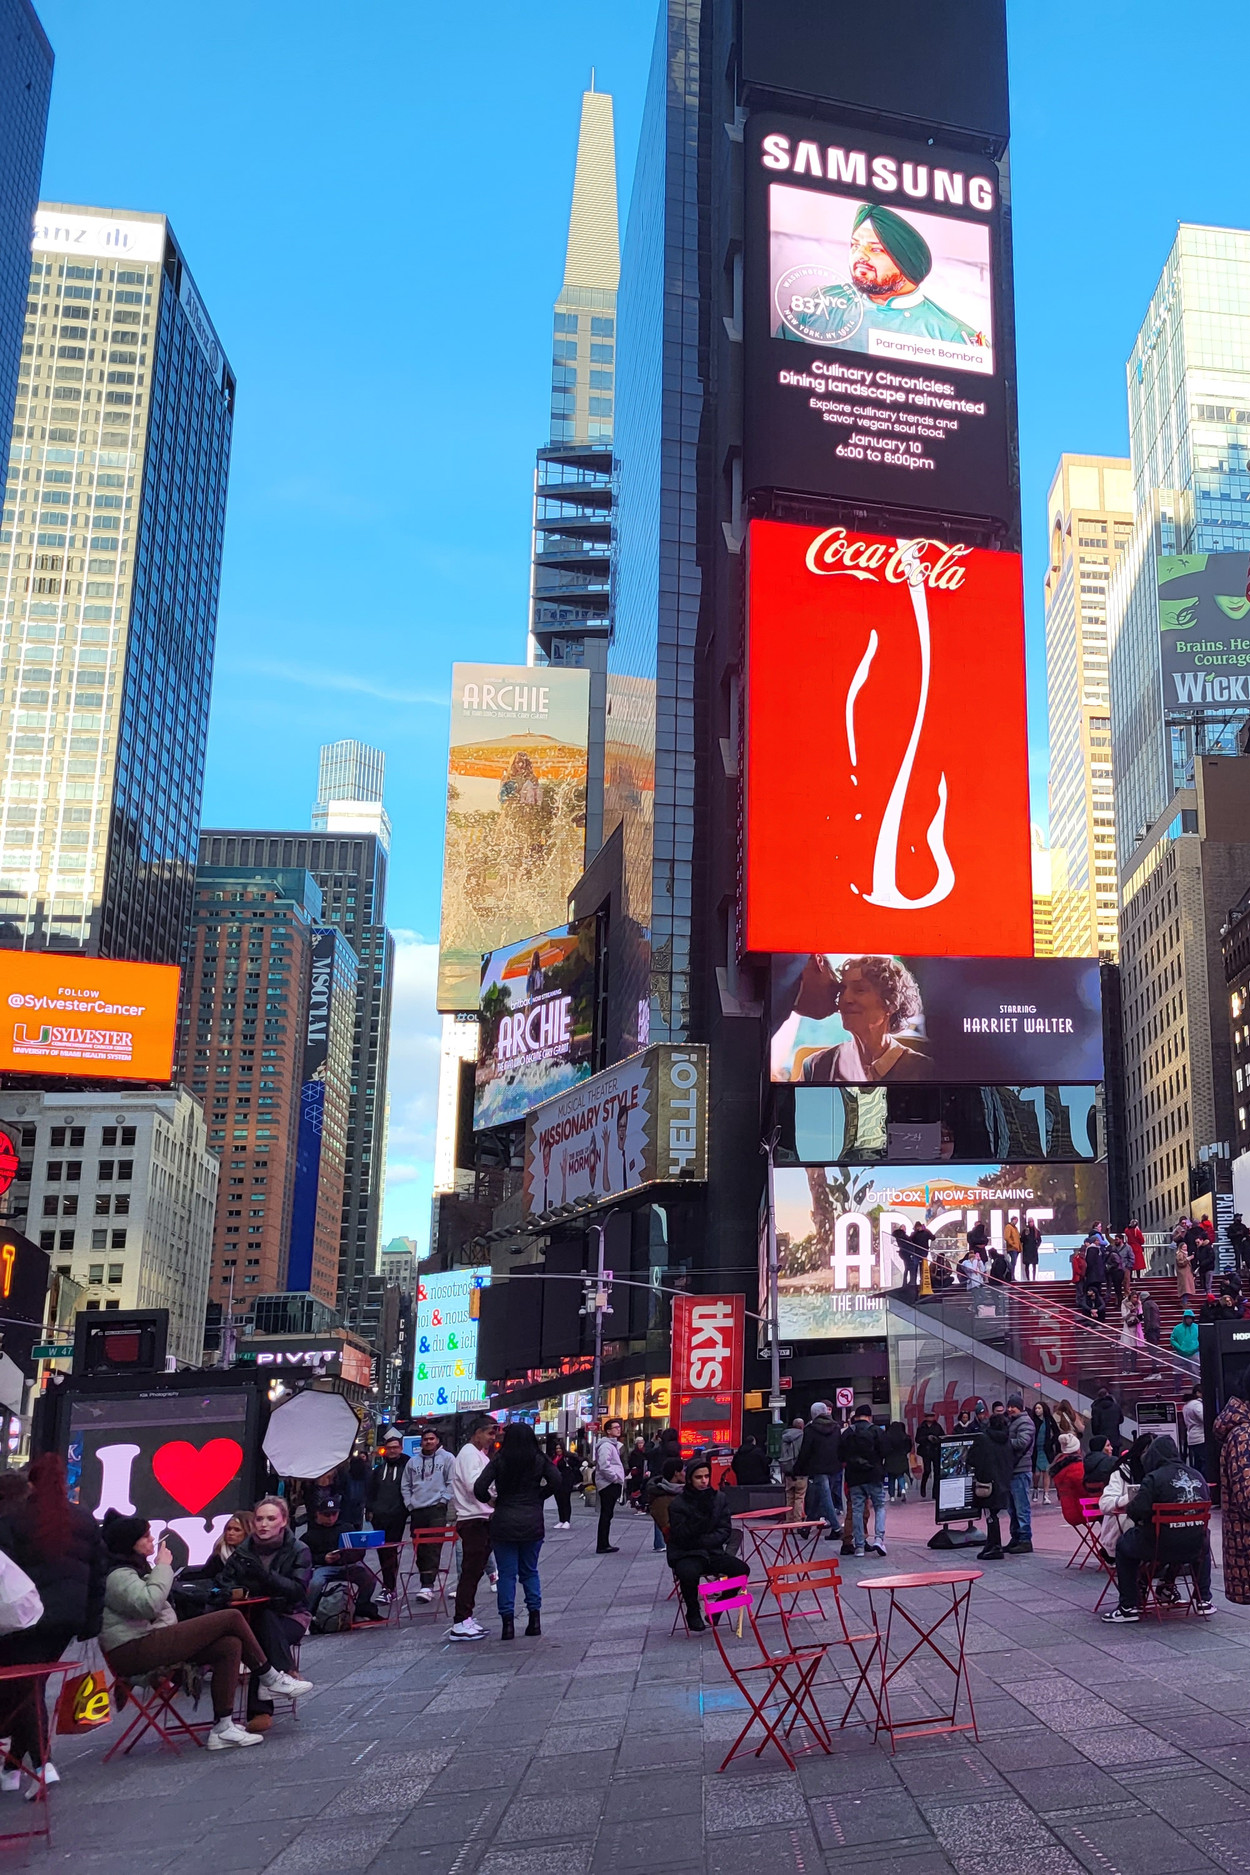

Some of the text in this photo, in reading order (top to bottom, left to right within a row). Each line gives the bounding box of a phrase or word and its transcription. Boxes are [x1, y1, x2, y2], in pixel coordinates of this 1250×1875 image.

[762, 133, 994, 211] SAMSUNG
[876, 338, 984, 364] Paramjeet Bombra
[811, 361, 955, 395] Culinary Chronicles:
[779, 371, 985, 415] Dining landscape reinvented
[809, 398, 958, 430] Explore culinary trends and
[823, 412, 945, 439] savor vegan soul food.
[848, 433, 922, 453] January 10
[835, 444, 934, 470] 6:00 to 8:00pm
[805, 527, 974, 591] Coca-Cola
[1176, 639, 1227, 653] Brains.
[462, 683, 550, 713] ARCHIE
[8, 993, 146, 1016] @SylvesterCancer
[58, 987, 100, 998] FOLLOW
[1000, 1005, 1037, 1014] STARRING
[52, 1027, 133, 1046] SYLVESTER
[497, 996, 571, 1060] ARCHIE
[963, 1018, 1074, 1033] HARRIET WALTER
[12, 1046, 50, 1056] UNIVERSITY
[558, 1077, 618, 1119] MUSICAL THEATER
[539, 1084, 639, 1152] MISSIONARY STYLE
[668, 1052, 698, 1175] HELLO!
[866, 1187, 1034, 1203] britbox NOW STREAMING
[430, 1281, 472, 1299] nosotros
[831, 1295, 852, 1311] THE
[445, 1310, 468, 1325] nous
[49, 1346, 73, 1356] W 47
[433, 1334, 444, 1351] du
[460, 1331, 476, 1349] ich
[689, 1301, 734, 1389] tkts
[92, 1443, 141, 1520] I
